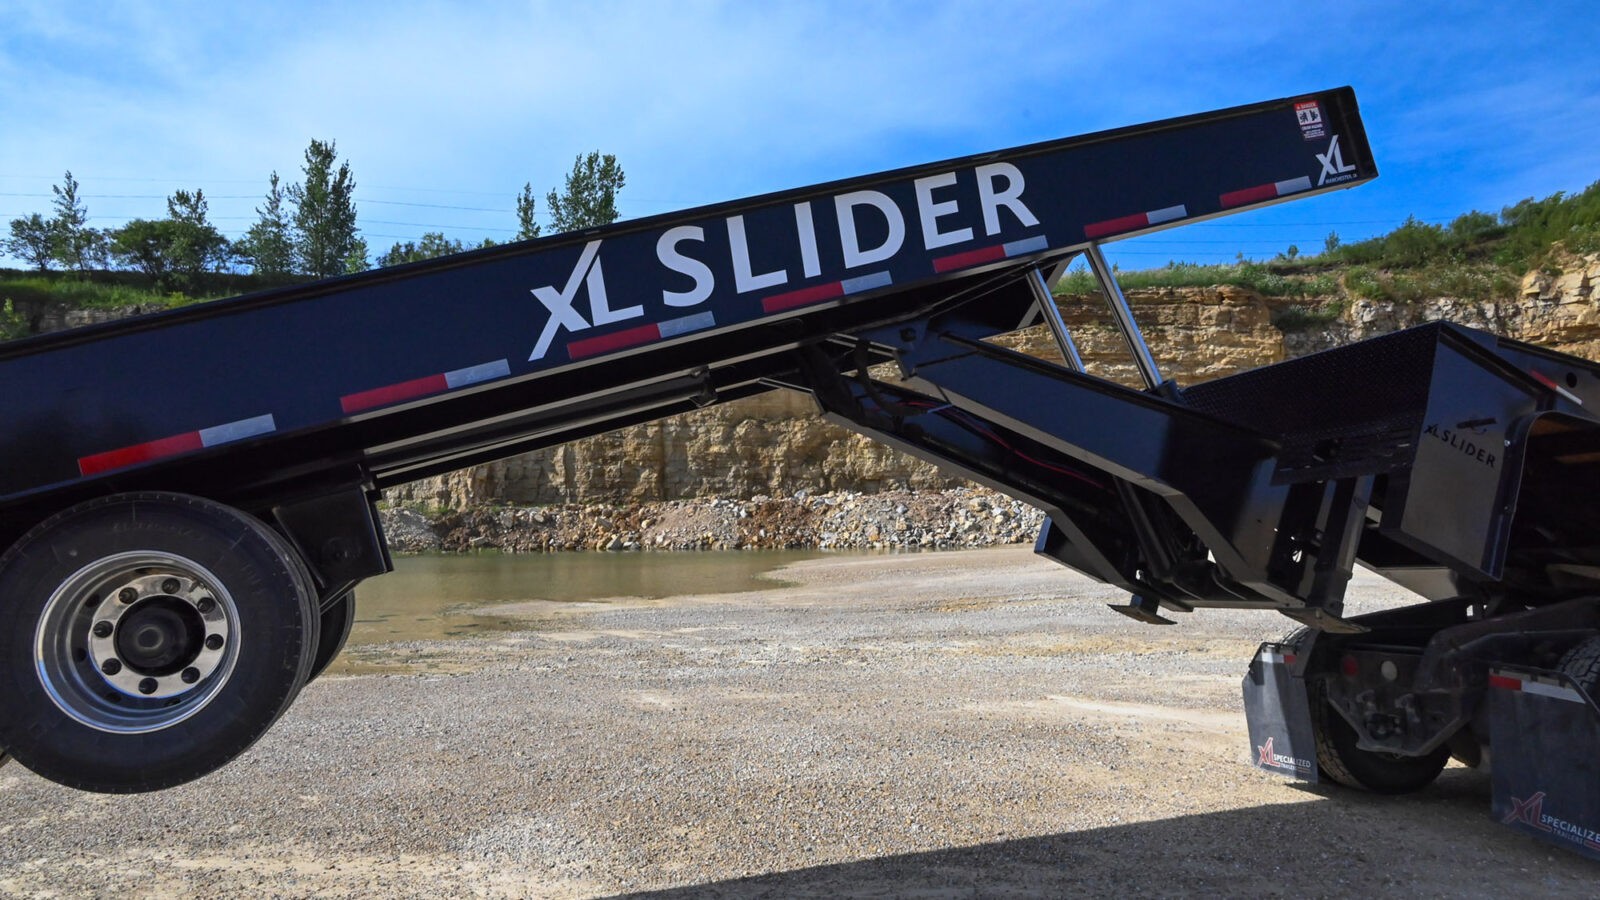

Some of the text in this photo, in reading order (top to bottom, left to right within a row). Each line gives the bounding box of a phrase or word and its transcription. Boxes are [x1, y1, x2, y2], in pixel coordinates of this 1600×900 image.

[1315, 135, 1355, 186] XL
[528, 162, 1040, 361] XL SLIDER
[1424, 423, 1495, 468] XL SLIDER
[1257, 737, 1311, 768] XL SPECIALIZED
[1501, 791, 1553, 833] XL
